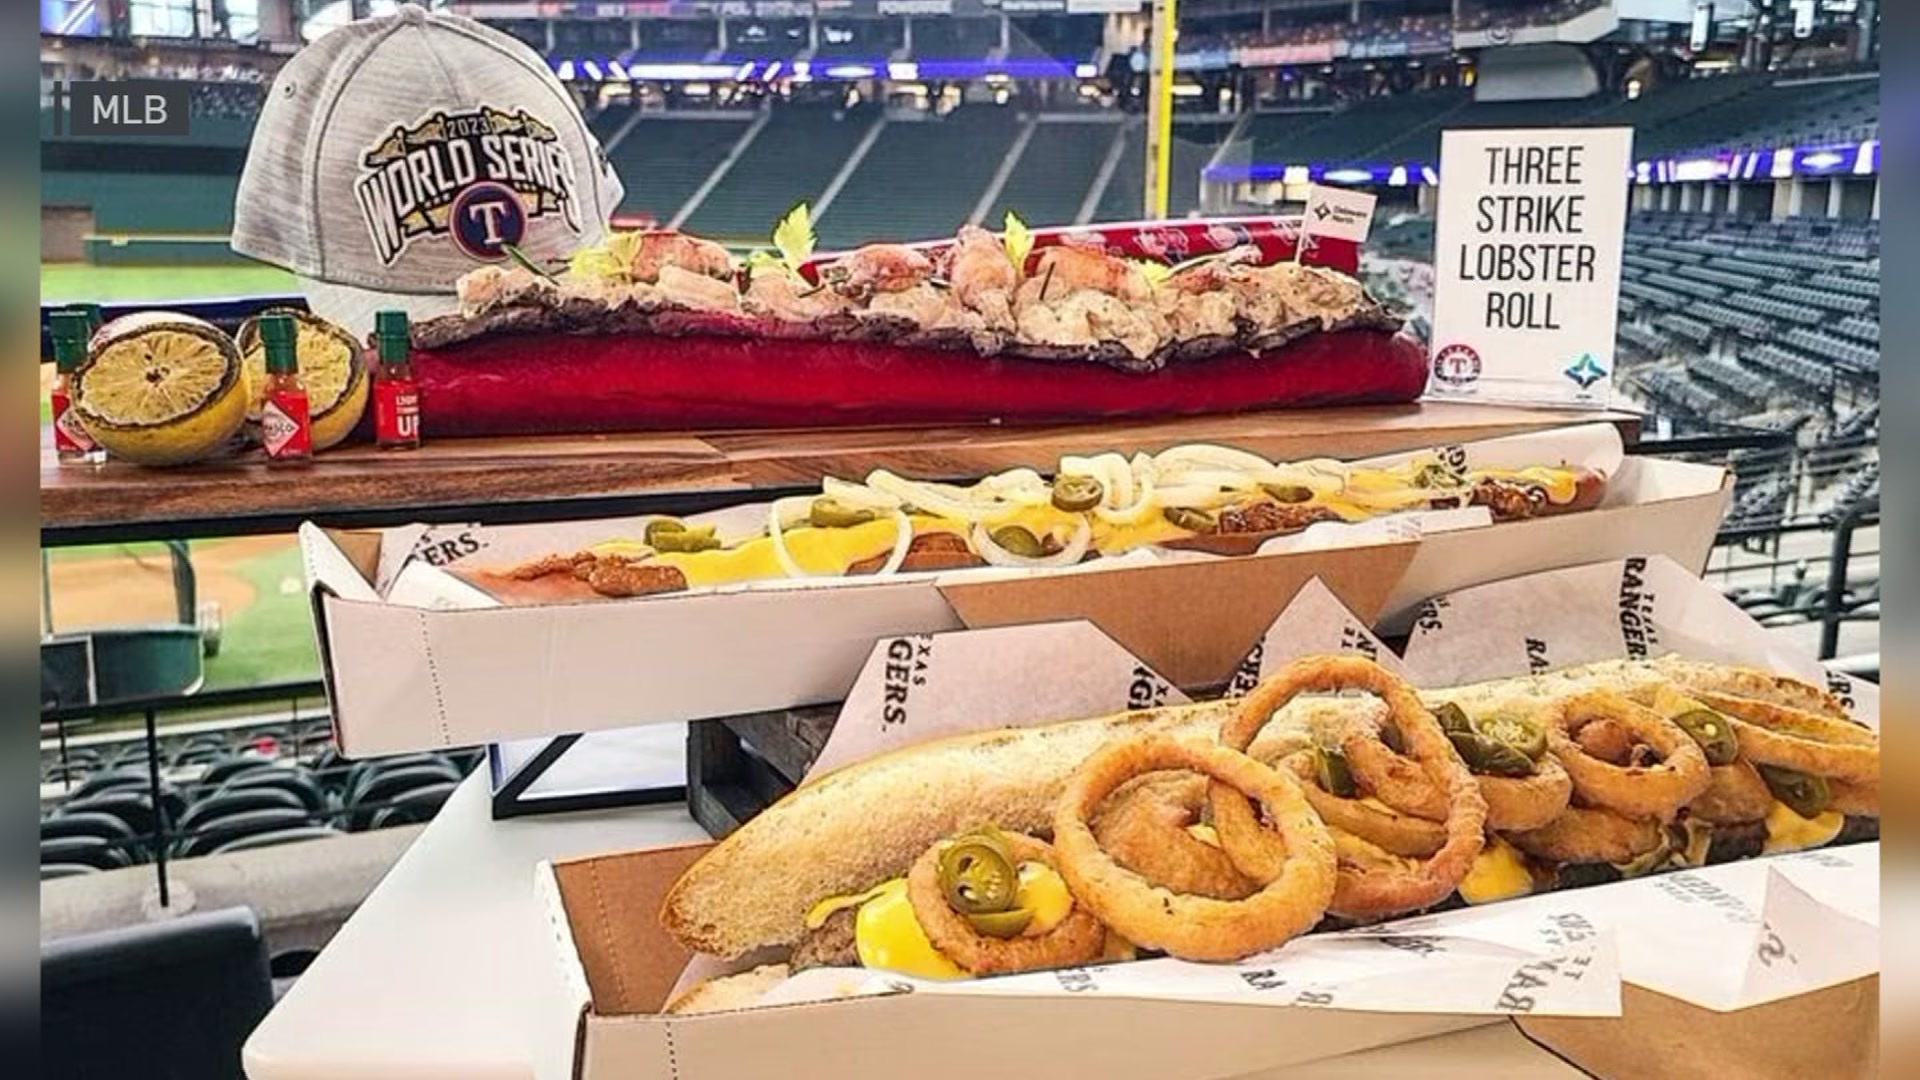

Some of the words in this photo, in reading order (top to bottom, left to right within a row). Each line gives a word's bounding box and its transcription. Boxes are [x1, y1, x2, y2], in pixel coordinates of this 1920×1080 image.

[449, 117, 491, 138] 2023
[1485, 145, 1585, 185] THREE
[358, 138, 475, 264] WORLD
[1477, 195, 1586, 234] STRIKE
[1459, 243, 1597, 283] LOBSTER
[1486, 291, 1561, 330] ROLL
[1618, 557, 1648, 661] RANGER
[1525, 638, 1550, 675] RA
